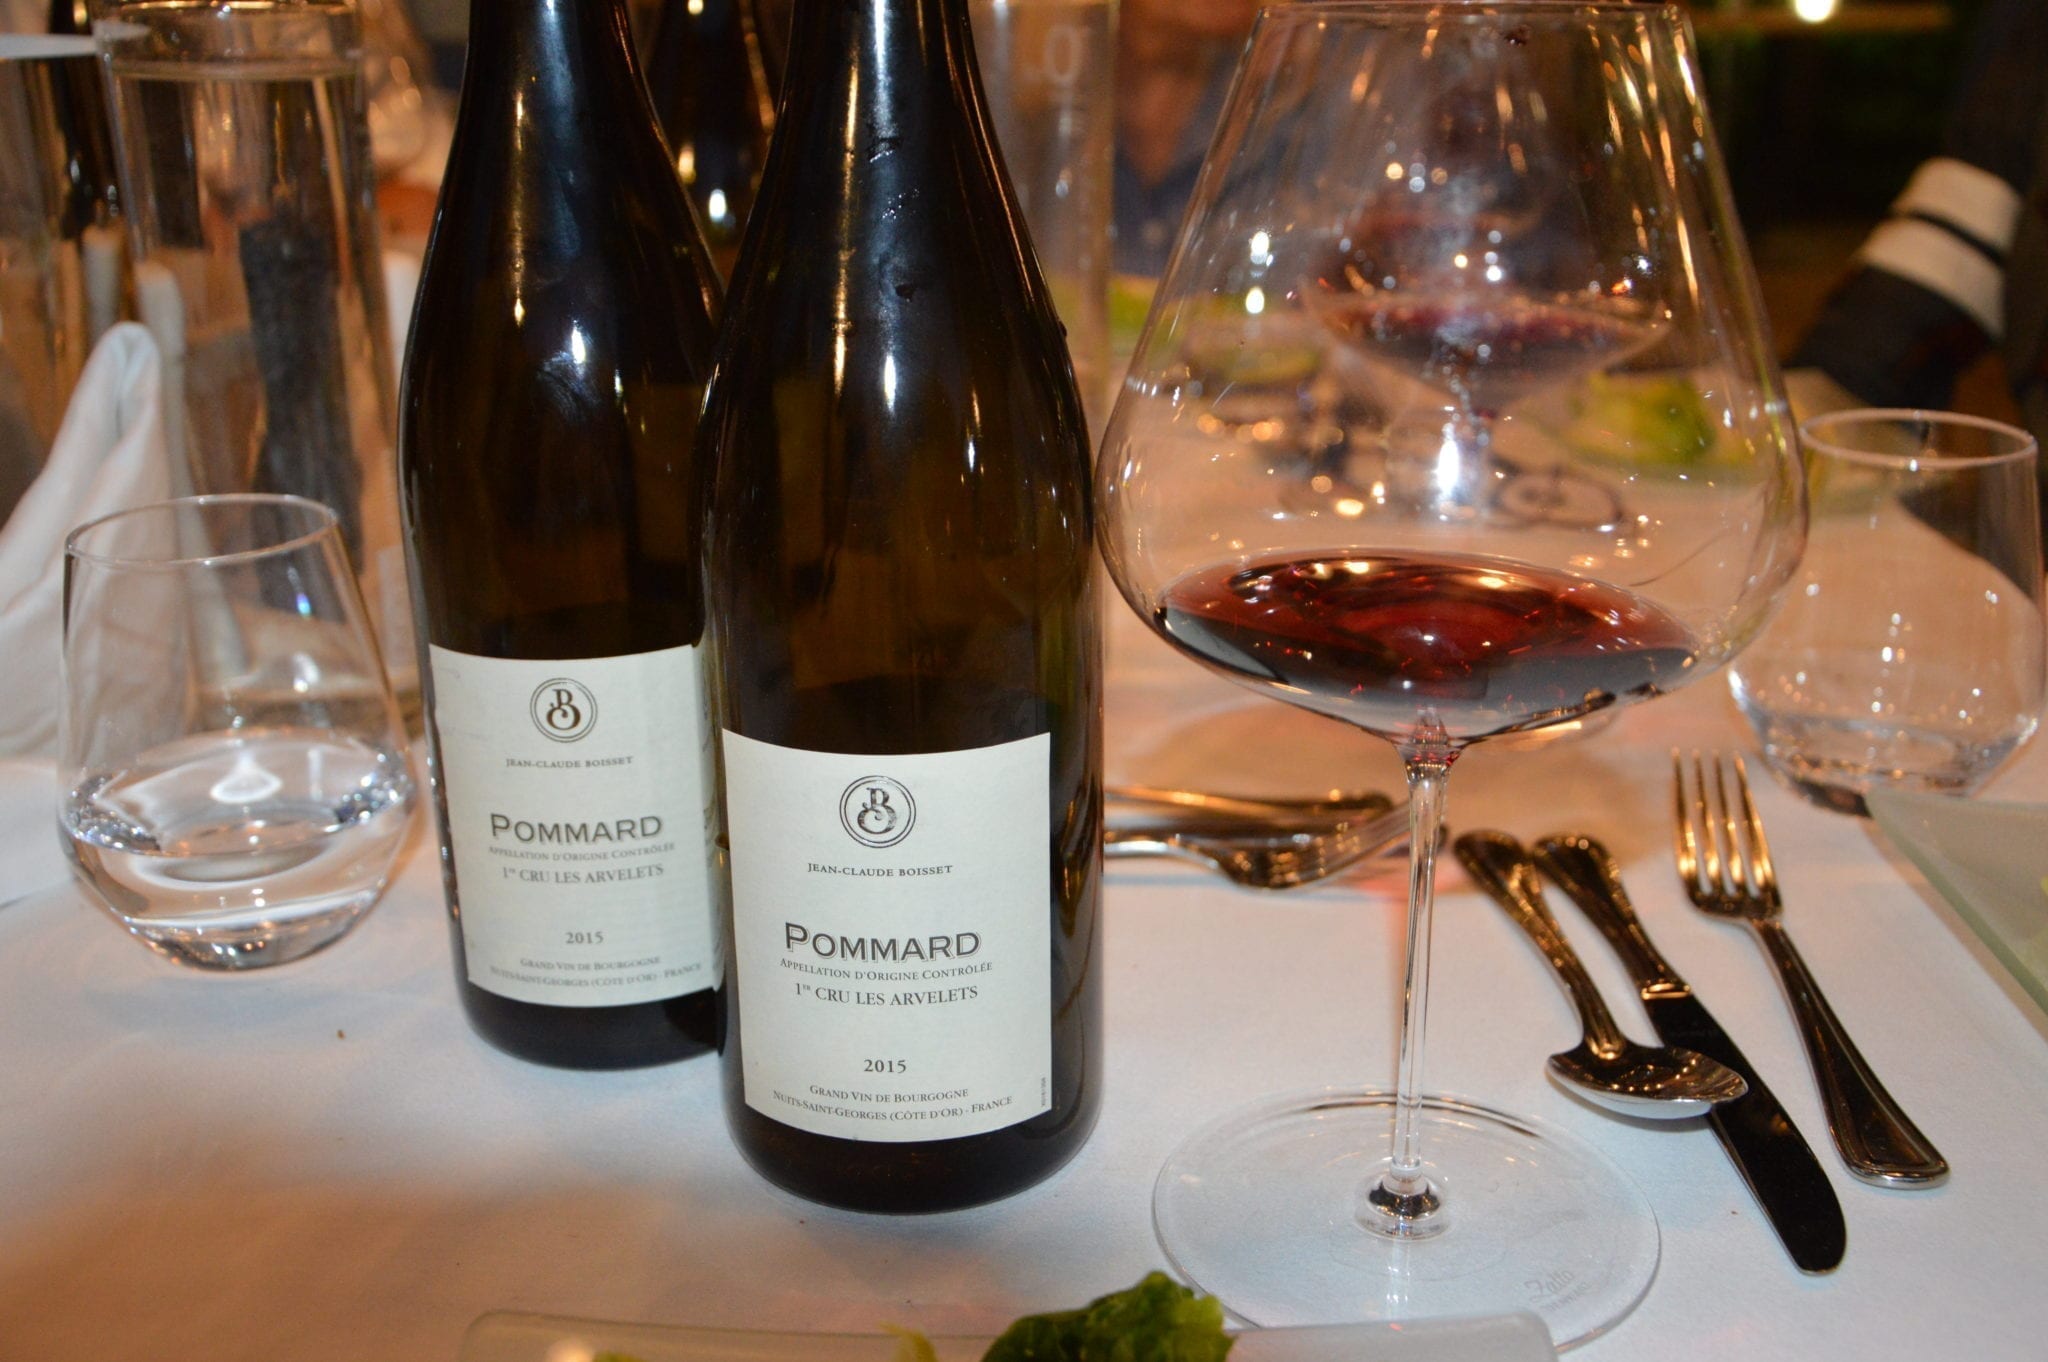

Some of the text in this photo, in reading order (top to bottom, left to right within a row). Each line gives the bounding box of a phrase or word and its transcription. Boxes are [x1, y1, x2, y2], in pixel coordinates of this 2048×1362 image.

[506, 756, 634, 769] JEAN-CLAUDE BOISSET
[490, 813, 663, 844] POMMARD
[519, 869, 550, 883] CRU
[554, 871, 581, 884] LES
[585, 863, 664, 884] ARVELETS
[807, 863, 953, 877] JEAN-CLAUDE BOISSET
[565, 931, 604, 945] 2015
[785, 921, 983, 963] POMMARD
[780, 957, 851, 979] APPELLATION
[855, 970, 919, 981] D'ORIGINE
[815, 986, 850, 1004] CRU
[856, 991, 885, 1006] LES
[889, 985, 979, 1006] ARVELETS
[863, 1059, 907, 1073] 2015
[809, 1084, 969, 1103] GRAND VIN DE BOURGOGNE
[971, 1096, 1013, 1114] FRANCE
